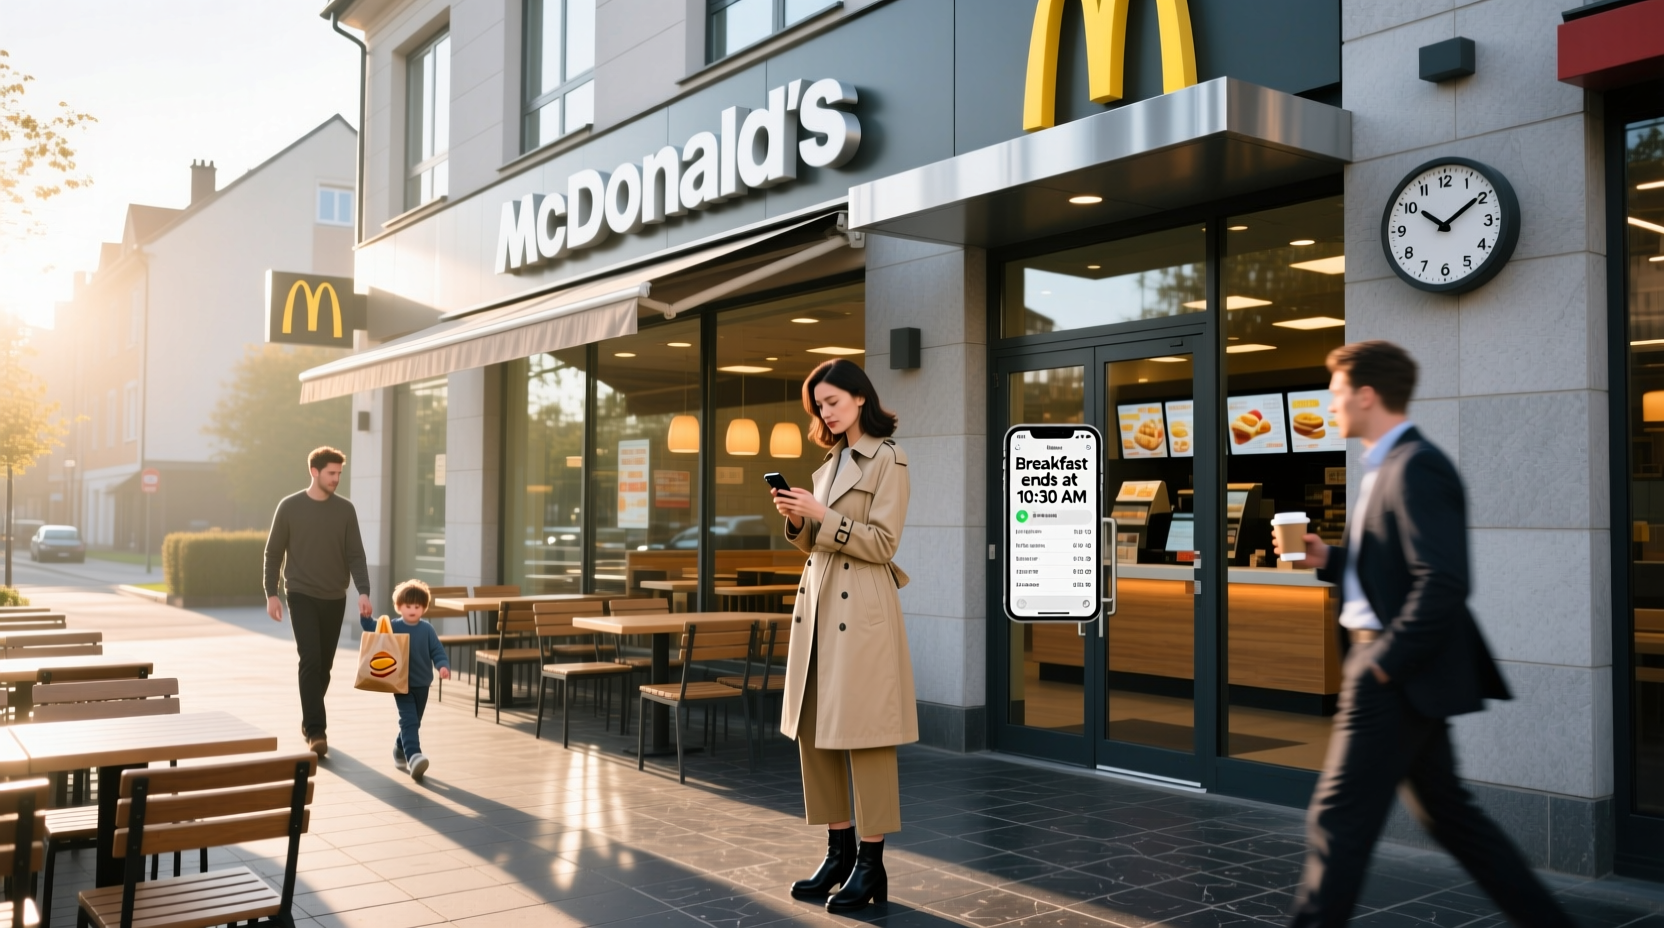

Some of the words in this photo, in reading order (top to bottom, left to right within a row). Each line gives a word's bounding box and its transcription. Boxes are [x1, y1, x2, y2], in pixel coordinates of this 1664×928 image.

[495, 77, 861, 275] McDonald's
[1438, 174, 1453, 189] 12
[1420, 183, 1429, 196] 11
[1464, 177, 1469, 189] 1
[1477, 191, 1488, 205] 2
[1404, 201, 1418, 214] 10
[1483, 213, 1493, 227] 3
[1397, 225, 1407, 237] 9
[1477, 237, 1486, 250] 4
[1404, 246, 1414, 259] 8
[1420, 260, 1429, 272] 7
[1463, 255, 1472, 267] 5
[1440, 263, 1450, 276] 6
[1015, 455, 1089, 470] Breakfast
[1021, 472, 1058, 487] ends
[1062, 473, 1078, 487] at
[1017, 490, 1058, 503] 10:30
[1061, 490, 1087, 503] AM
